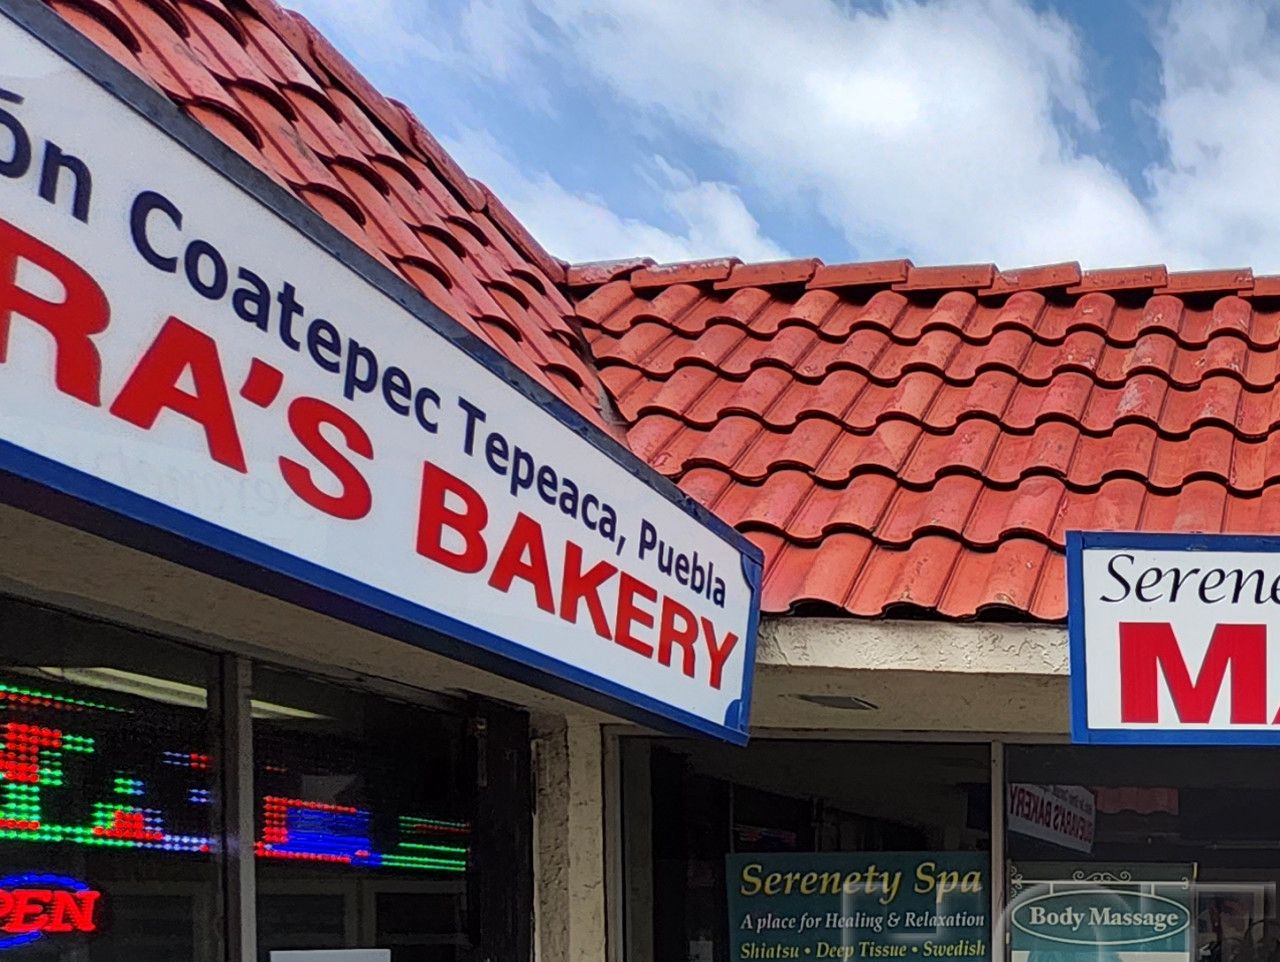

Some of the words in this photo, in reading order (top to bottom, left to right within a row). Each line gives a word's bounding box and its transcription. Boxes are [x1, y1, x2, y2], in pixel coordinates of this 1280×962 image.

[130, 190, 441, 434] Coatepec
[458, 396, 626, 556] Tepeaca,
[638, 518, 727, 608] Puebla
[416, 461, 739, 690] BAKERY
[741, 864, 902, 904] Serenety
[914, 862, 983, 904] Spa
[741, 915, 753, 929] A
[757, 912, 796, 933] place
[799, 912, 822, 933] for
[826, 912, 883, 932] Healing
[888, 912, 900, 927] &
[905, 911, 985, 928] Relaxation
[1029, 907, 1085, 931] Body
[1088, 907, 1179, 931] Massage
[741, 942, 799, 959] Shiatsu
[816, 942, 854, 961] Deep
[859, 941, 907, 957] Tissue
[923, 939, 985, 957] Swedish
